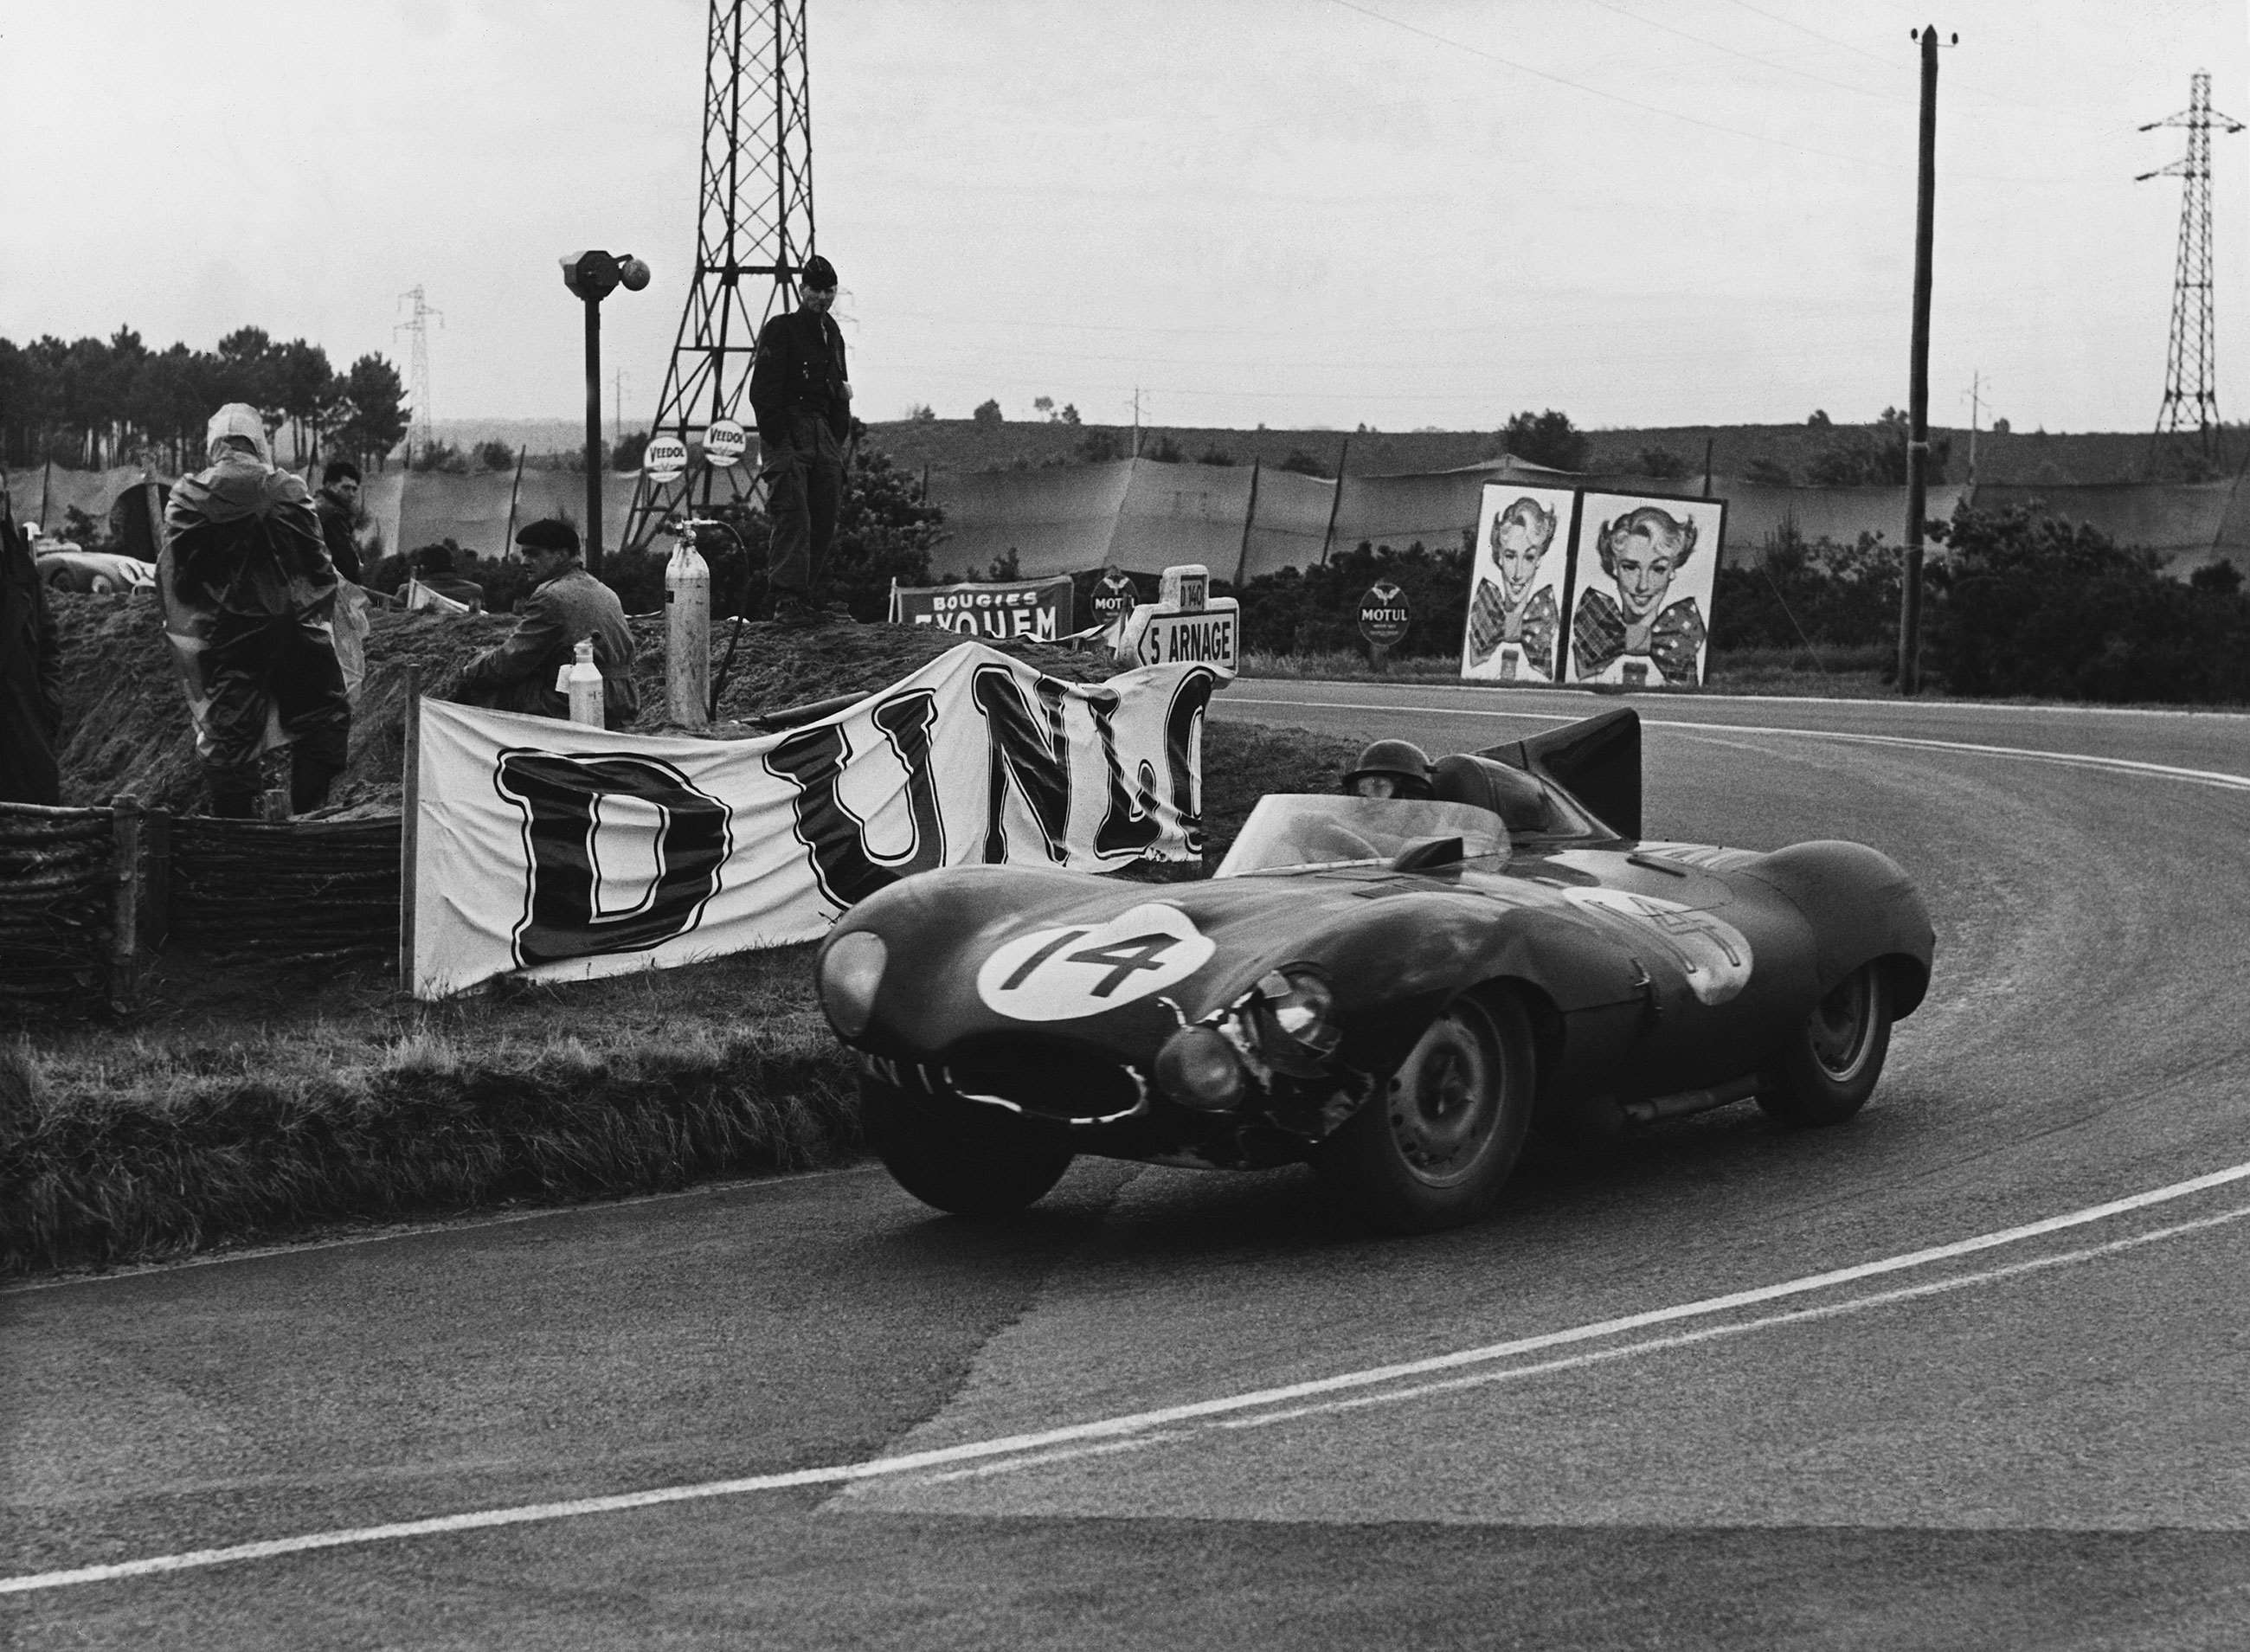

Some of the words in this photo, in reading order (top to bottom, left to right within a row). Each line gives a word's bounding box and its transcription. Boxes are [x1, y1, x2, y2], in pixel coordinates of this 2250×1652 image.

[710, 427, 744, 445] VEEDOL
[650, 446, 685, 463] VEEDOL
[933, 591, 1038, 611] BOUGIES
[1095, 597, 1135, 610] MOTL
[915, 606, 1057, 641] YQUEM
[1361, 608, 1407, 621] MOTUL
[1150, 627, 1160, 665] 5
[1169, 620, 1231, 663] ARNAGE
[1582, 897, 1741, 974] 14
[1000, 929, 1183, 998] 14
